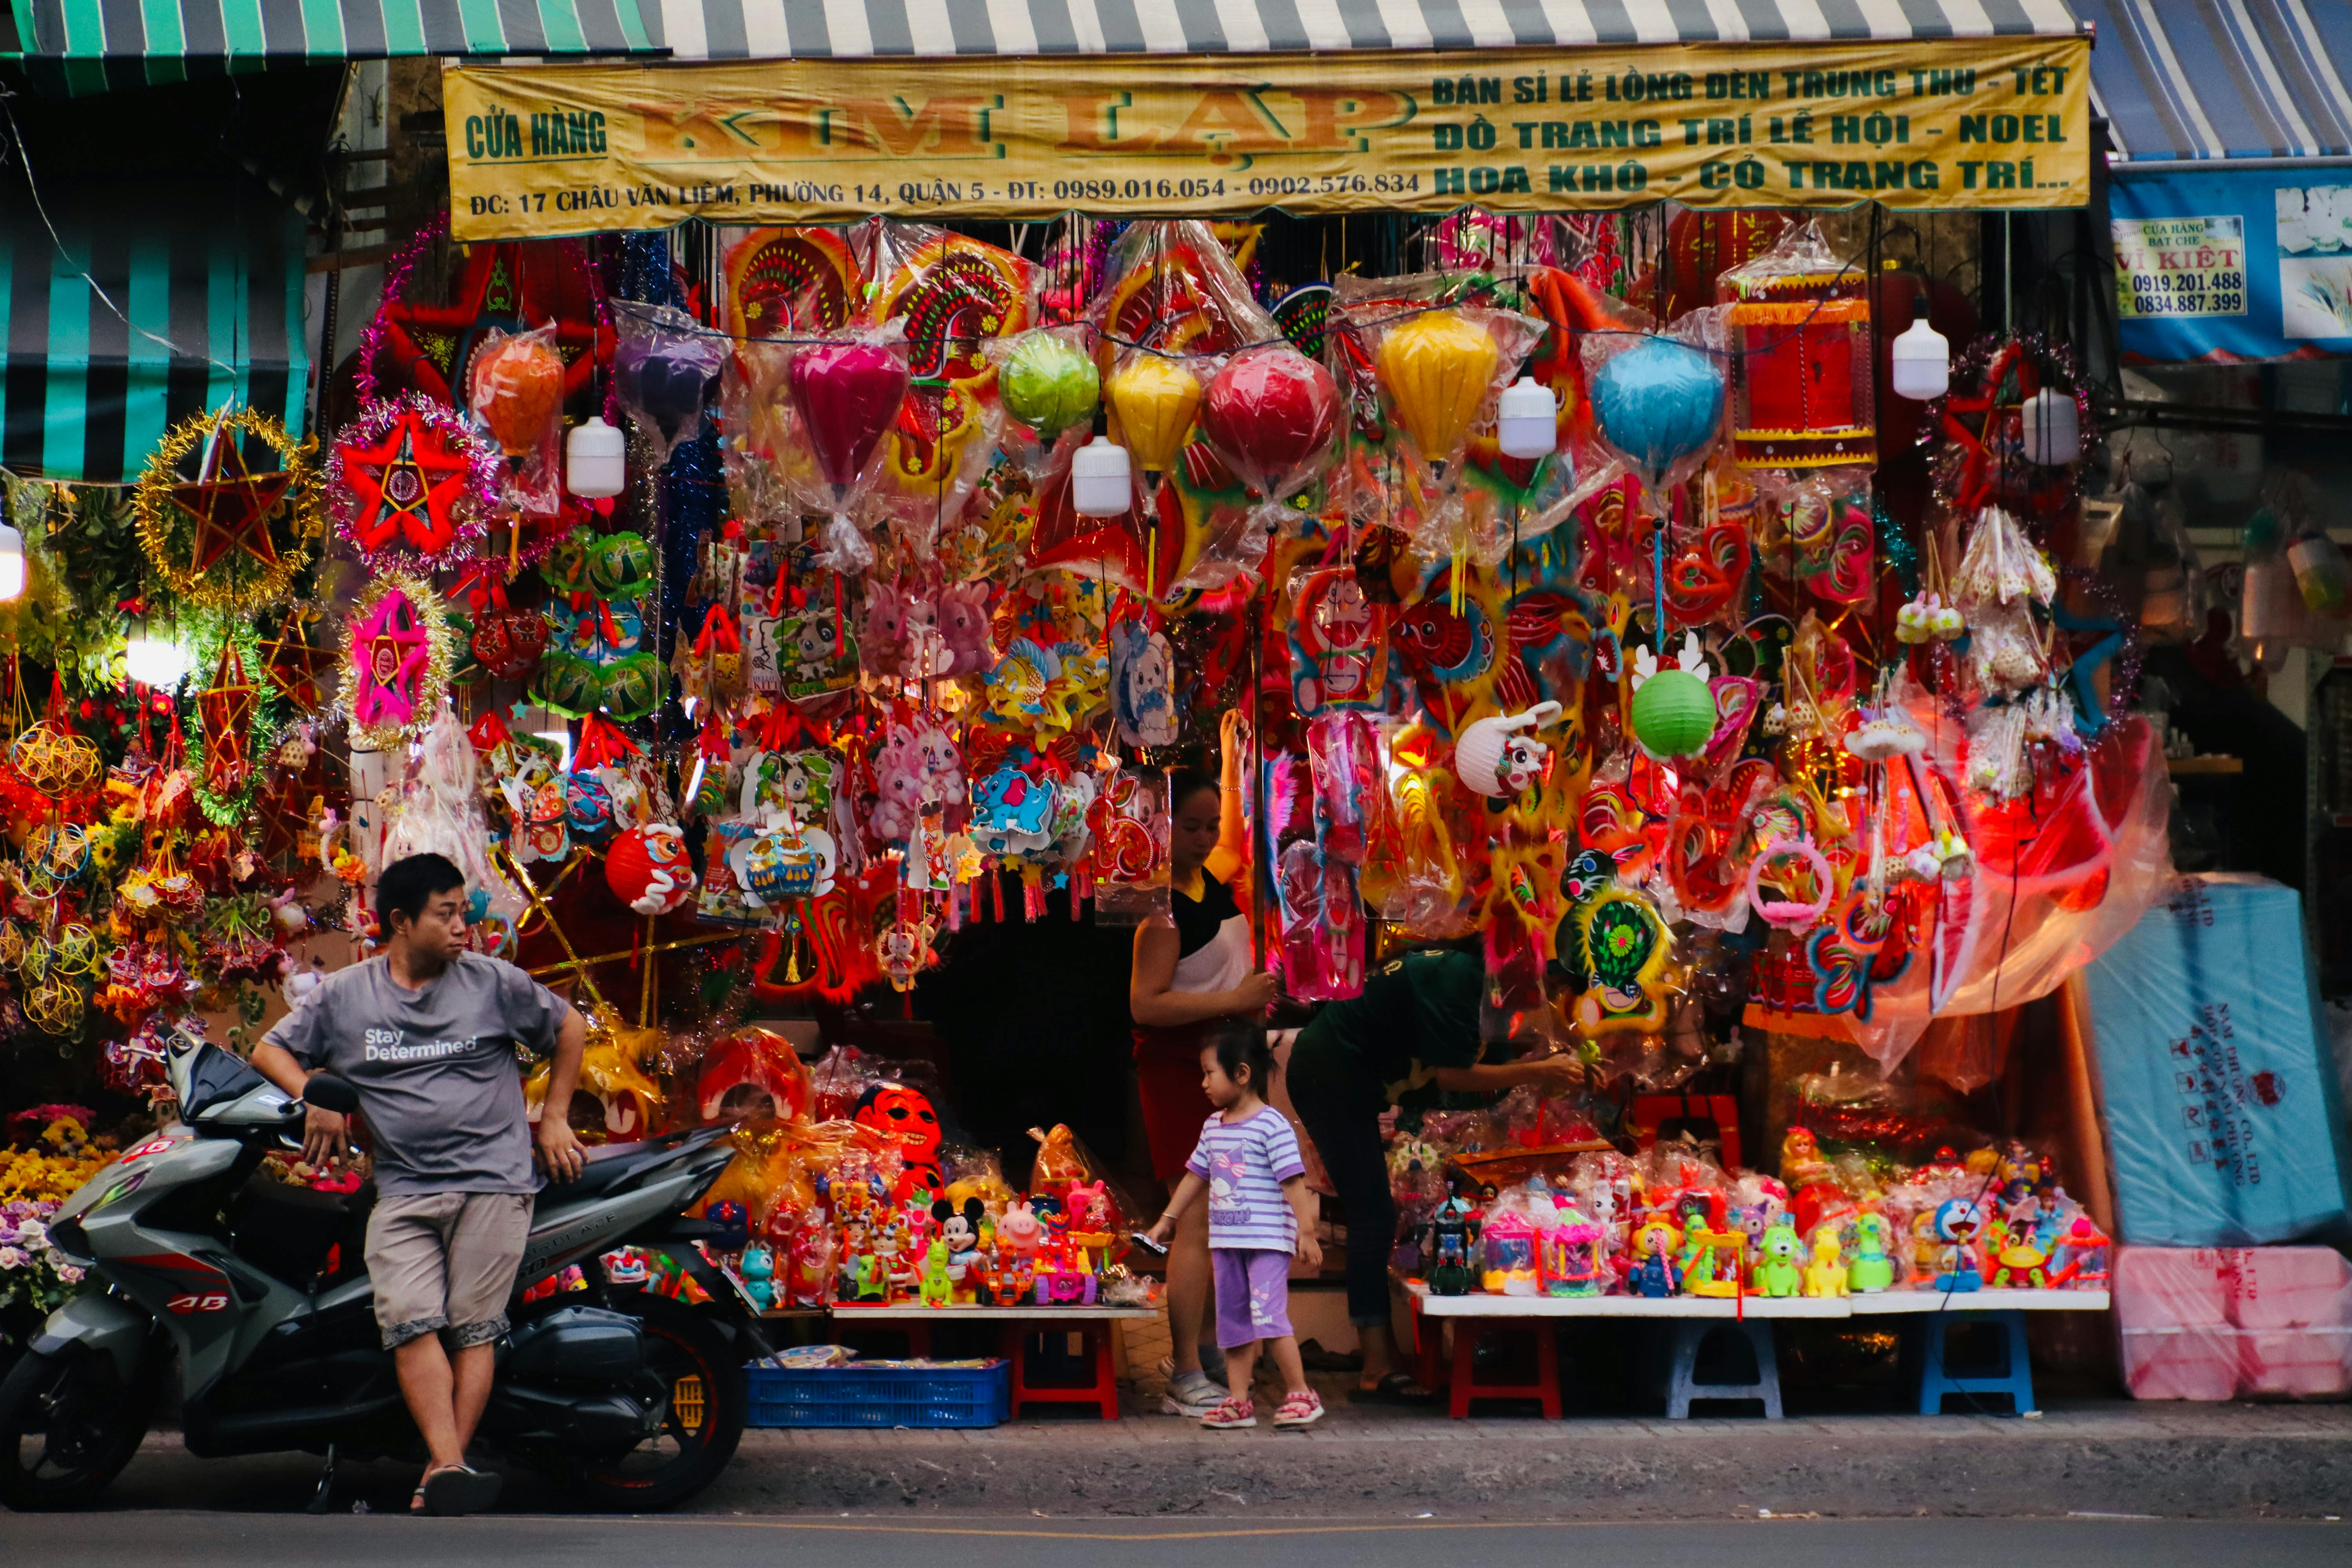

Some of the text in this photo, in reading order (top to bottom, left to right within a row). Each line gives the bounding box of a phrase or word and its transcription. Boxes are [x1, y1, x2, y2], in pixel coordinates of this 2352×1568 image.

[1432, 73, 1501, 105] BÁN
[1513, 69, 1548, 104] SỈ
[1560, 68, 1593, 103] LẺ
[1606, 65, 1693, 102] LỒNG
[1705, 68, 1770, 100] ĐÈN
[1782, 68, 1896, 99] TRUNG
[1908, 68, 1976, 97] THU
[465, 104, 608, 158] CỬA HÀNG
[627, 94, 1008, 160] KIM
[1432, 113, 1496, 150] ĐỒ
[1512, 119, 1662, 149] TRANG
[1677, 112, 1752, 145] TRÍ
[1770, 107, 1815, 144] LỄ
[1831, 111, 1909, 149] HỘI
[1959, 114, 2067, 143] NOEL
[1434, 165, 1532, 195] HOA
[1548, 159, 1648, 193] KHÔ
[1782, 160, 1939, 190] TRANG
[470, 195, 509, 215] ĐC:
[519, 192, 546, 213] 17
[555, 184, 619, 211] CHÂU
[627, 183, 671, 207] VĂN
[679, 181, 740, 205] LIÊM,
[749, 180, 844, 203] PHƯỜNG
[853, 183, 889, 205] 14,
[898, 177, 962, 207] QUẬN
[971, 182, 985, 201] 5
[1008, 181, 1045, 201] ĐT:
[1053, 178, 1225, 200] 0989.016.054
[1249, 174, 1420, 196] 0902.576.834
[2158, 245, 2239, 273] KIỆT
[2133, 272, 2242, 292] 0919.201.488
[2135, 293, 2242, 313] 0834.887.399
[365, 1028, 404, 1046] Stay
[365, 1035, 477, 1061] Determined
[2246, 1153, 2261, 1185] LTD
